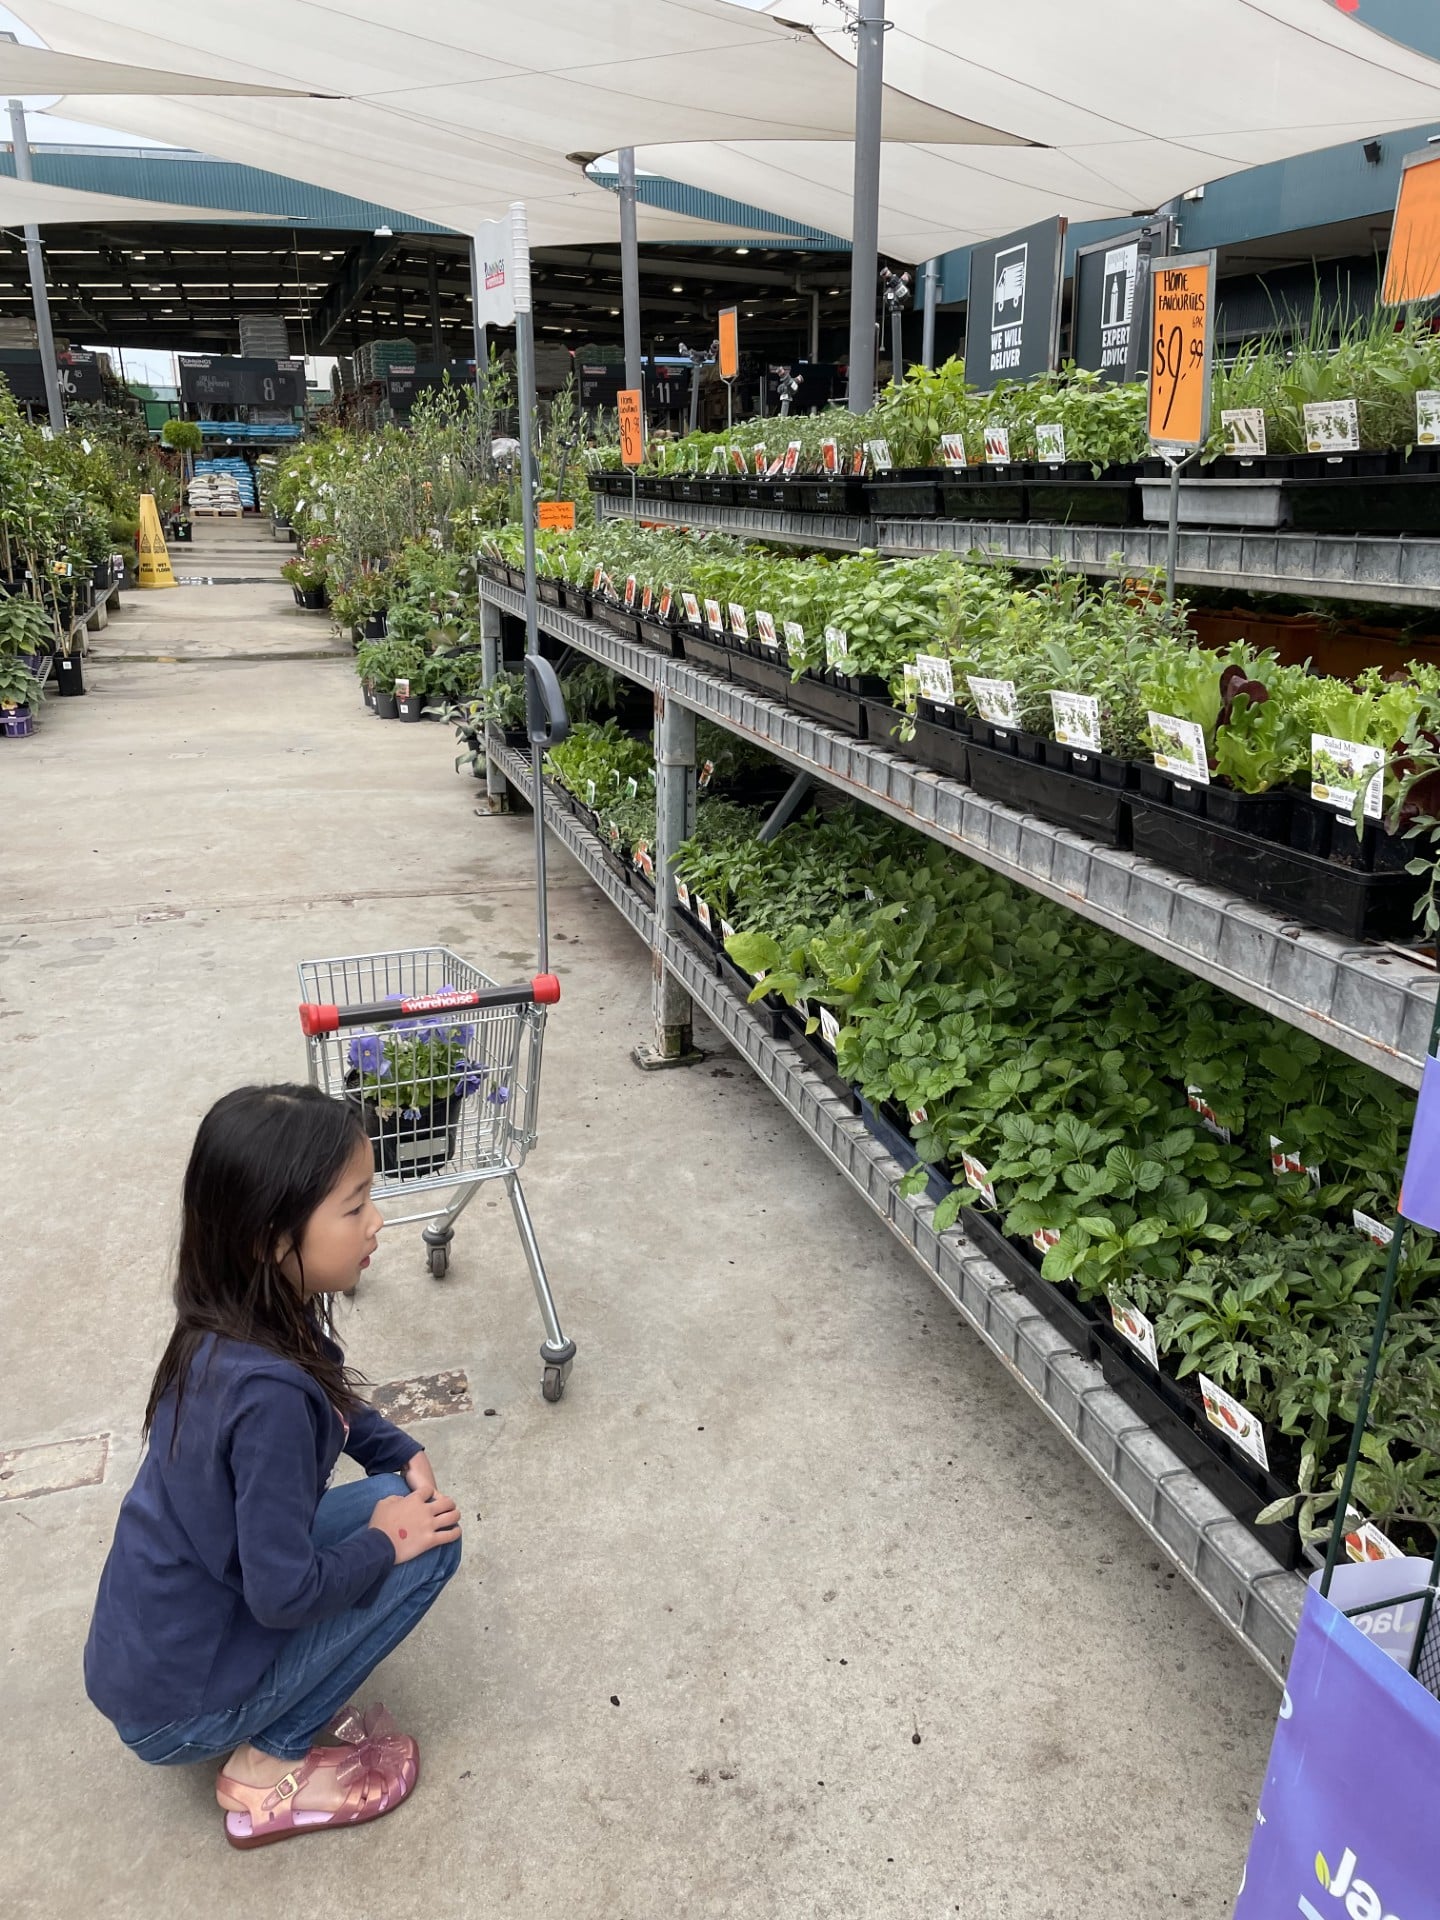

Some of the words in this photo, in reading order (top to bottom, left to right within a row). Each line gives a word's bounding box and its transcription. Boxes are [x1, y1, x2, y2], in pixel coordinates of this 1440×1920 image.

[1163, 270, 1188, 292] HOME
[990, 331, 1003, 351] WE
[1004, 327, 1022, 349] WILL
[1102, 326, 1130, 348] EXPERT
[989, 348, 1020, 371] DELIVER
[1324, 738, 1342, 750] Salad
[1343, 742, 1357, 753] Mix
[405, 995, 473, 1011] warehouse
[1328, 1846, 1401, 1920] Ja
